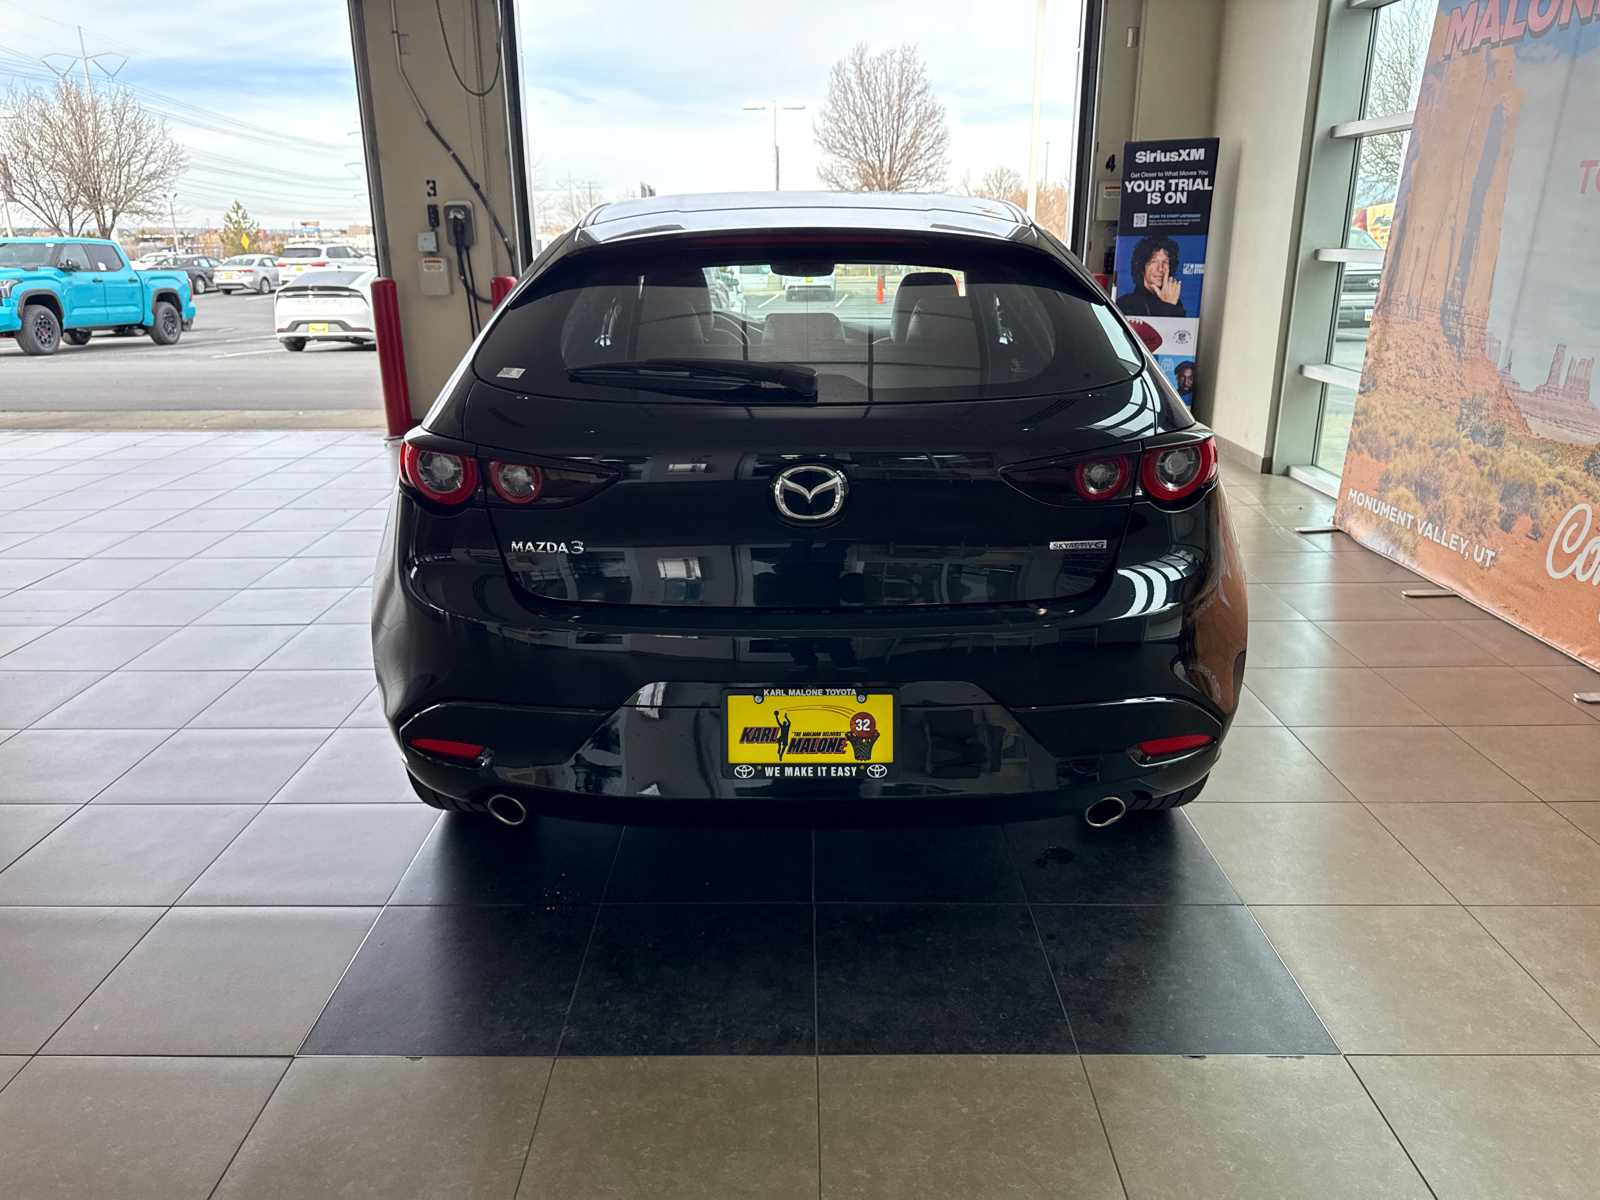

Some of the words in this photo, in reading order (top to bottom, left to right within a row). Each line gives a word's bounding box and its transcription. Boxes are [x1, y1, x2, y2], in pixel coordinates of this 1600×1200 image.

[1105, 154, 1116, 172] 4
[1135, 148, 1205, 164] SiriusXM
[426, 180, 437, 197] 3
[1125, 180, 1165, 193] YOUR
[1169, 178, 1213, 191] TRIAL
[1147, 192, 1161, 205] IS
[1164, 191, 1188, 204] ON
[1347, 487, 1414, 530] MONUMENT
[1417, 517, 1470, 560] VALLEY,
[1473, 546, 1496, 567] UT
[763, 688, 787, 696] KARL
[788, 688, 823, 696] MALONE
[825, 688, 857, 696] TOYOTA
[855, 718, 871, 731] 32
[739, 726, 780, 744] KARL
[786, 737, 848, 754] MALONE
[764, 766, 780, 777] WE
[784, 766, 814, 777] MAKE
[817, 766, 827, 777] IT
[830, 766, 857, 777] EASY
